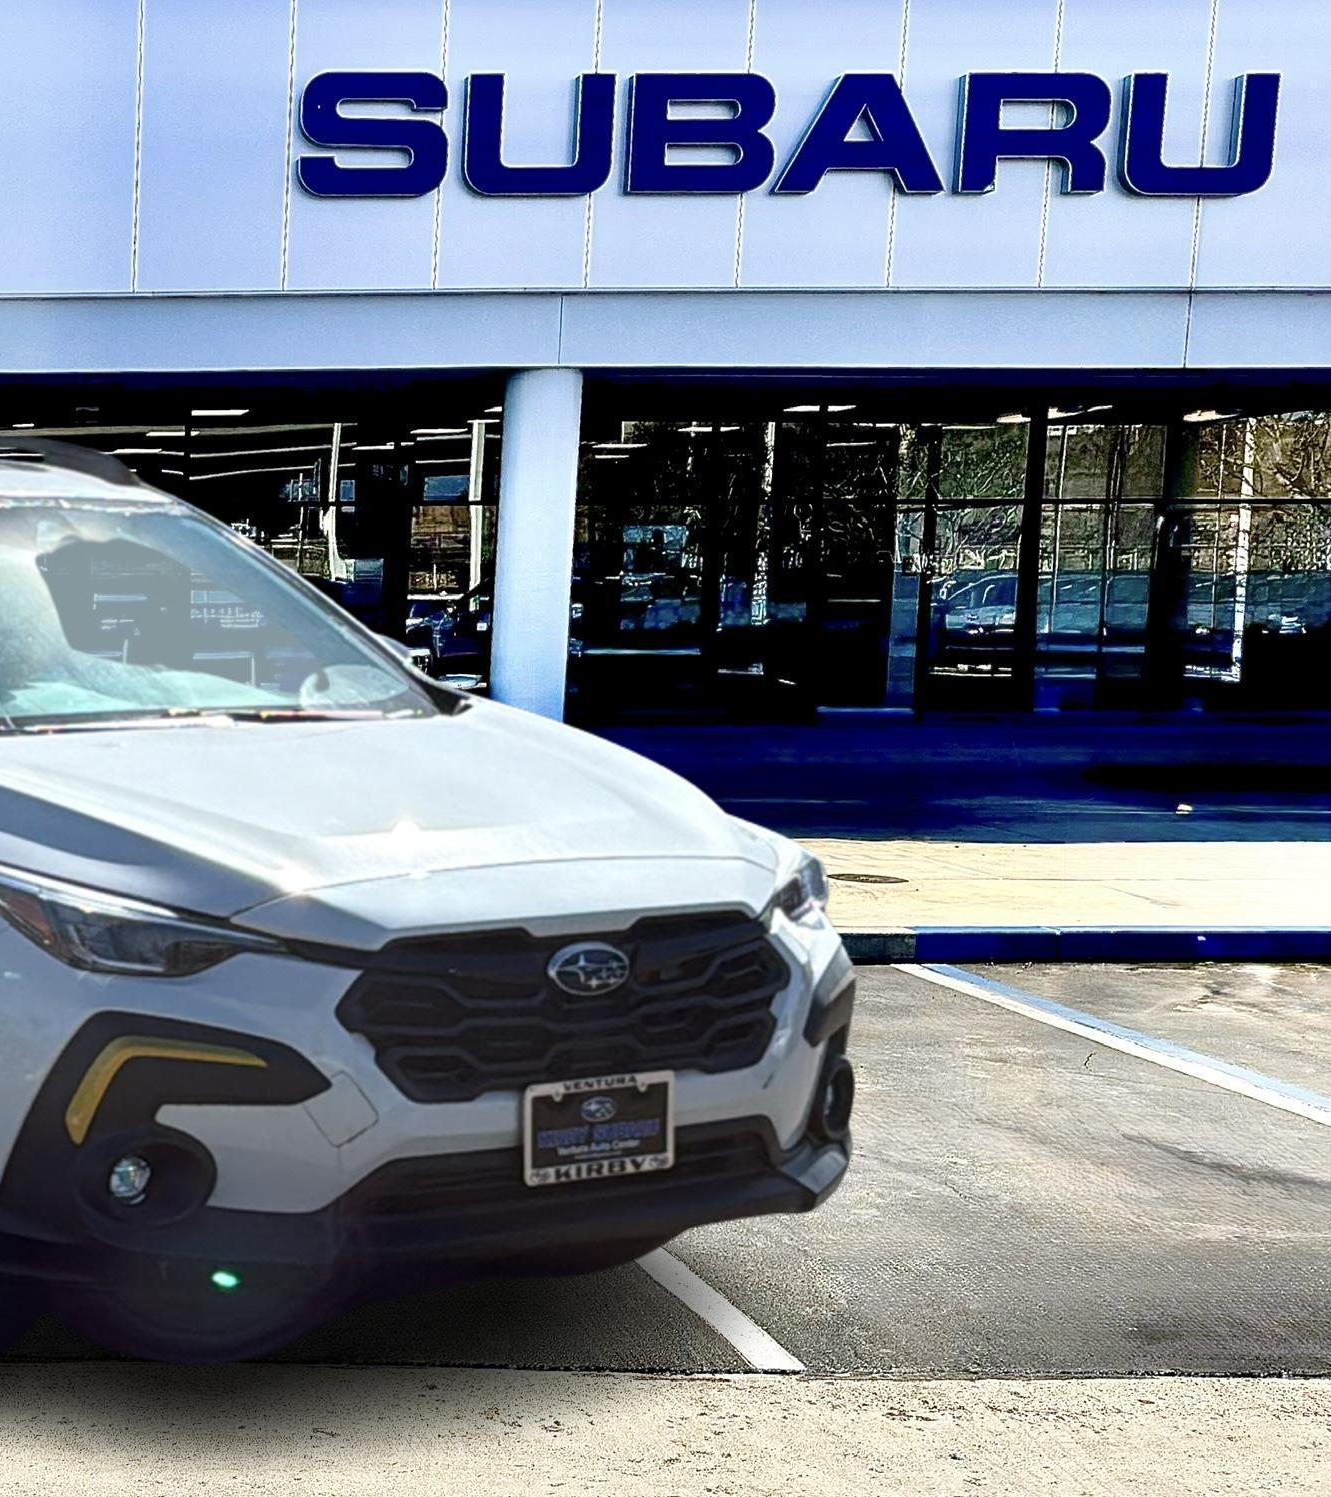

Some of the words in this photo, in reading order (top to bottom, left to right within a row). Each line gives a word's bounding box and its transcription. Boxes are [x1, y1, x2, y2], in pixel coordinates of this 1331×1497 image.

[296, 72, 1281, 198] SUBARU
[564, 1076, 638, 1091] VENTURA
[555, 1158, 647, 1181] KIRBY
